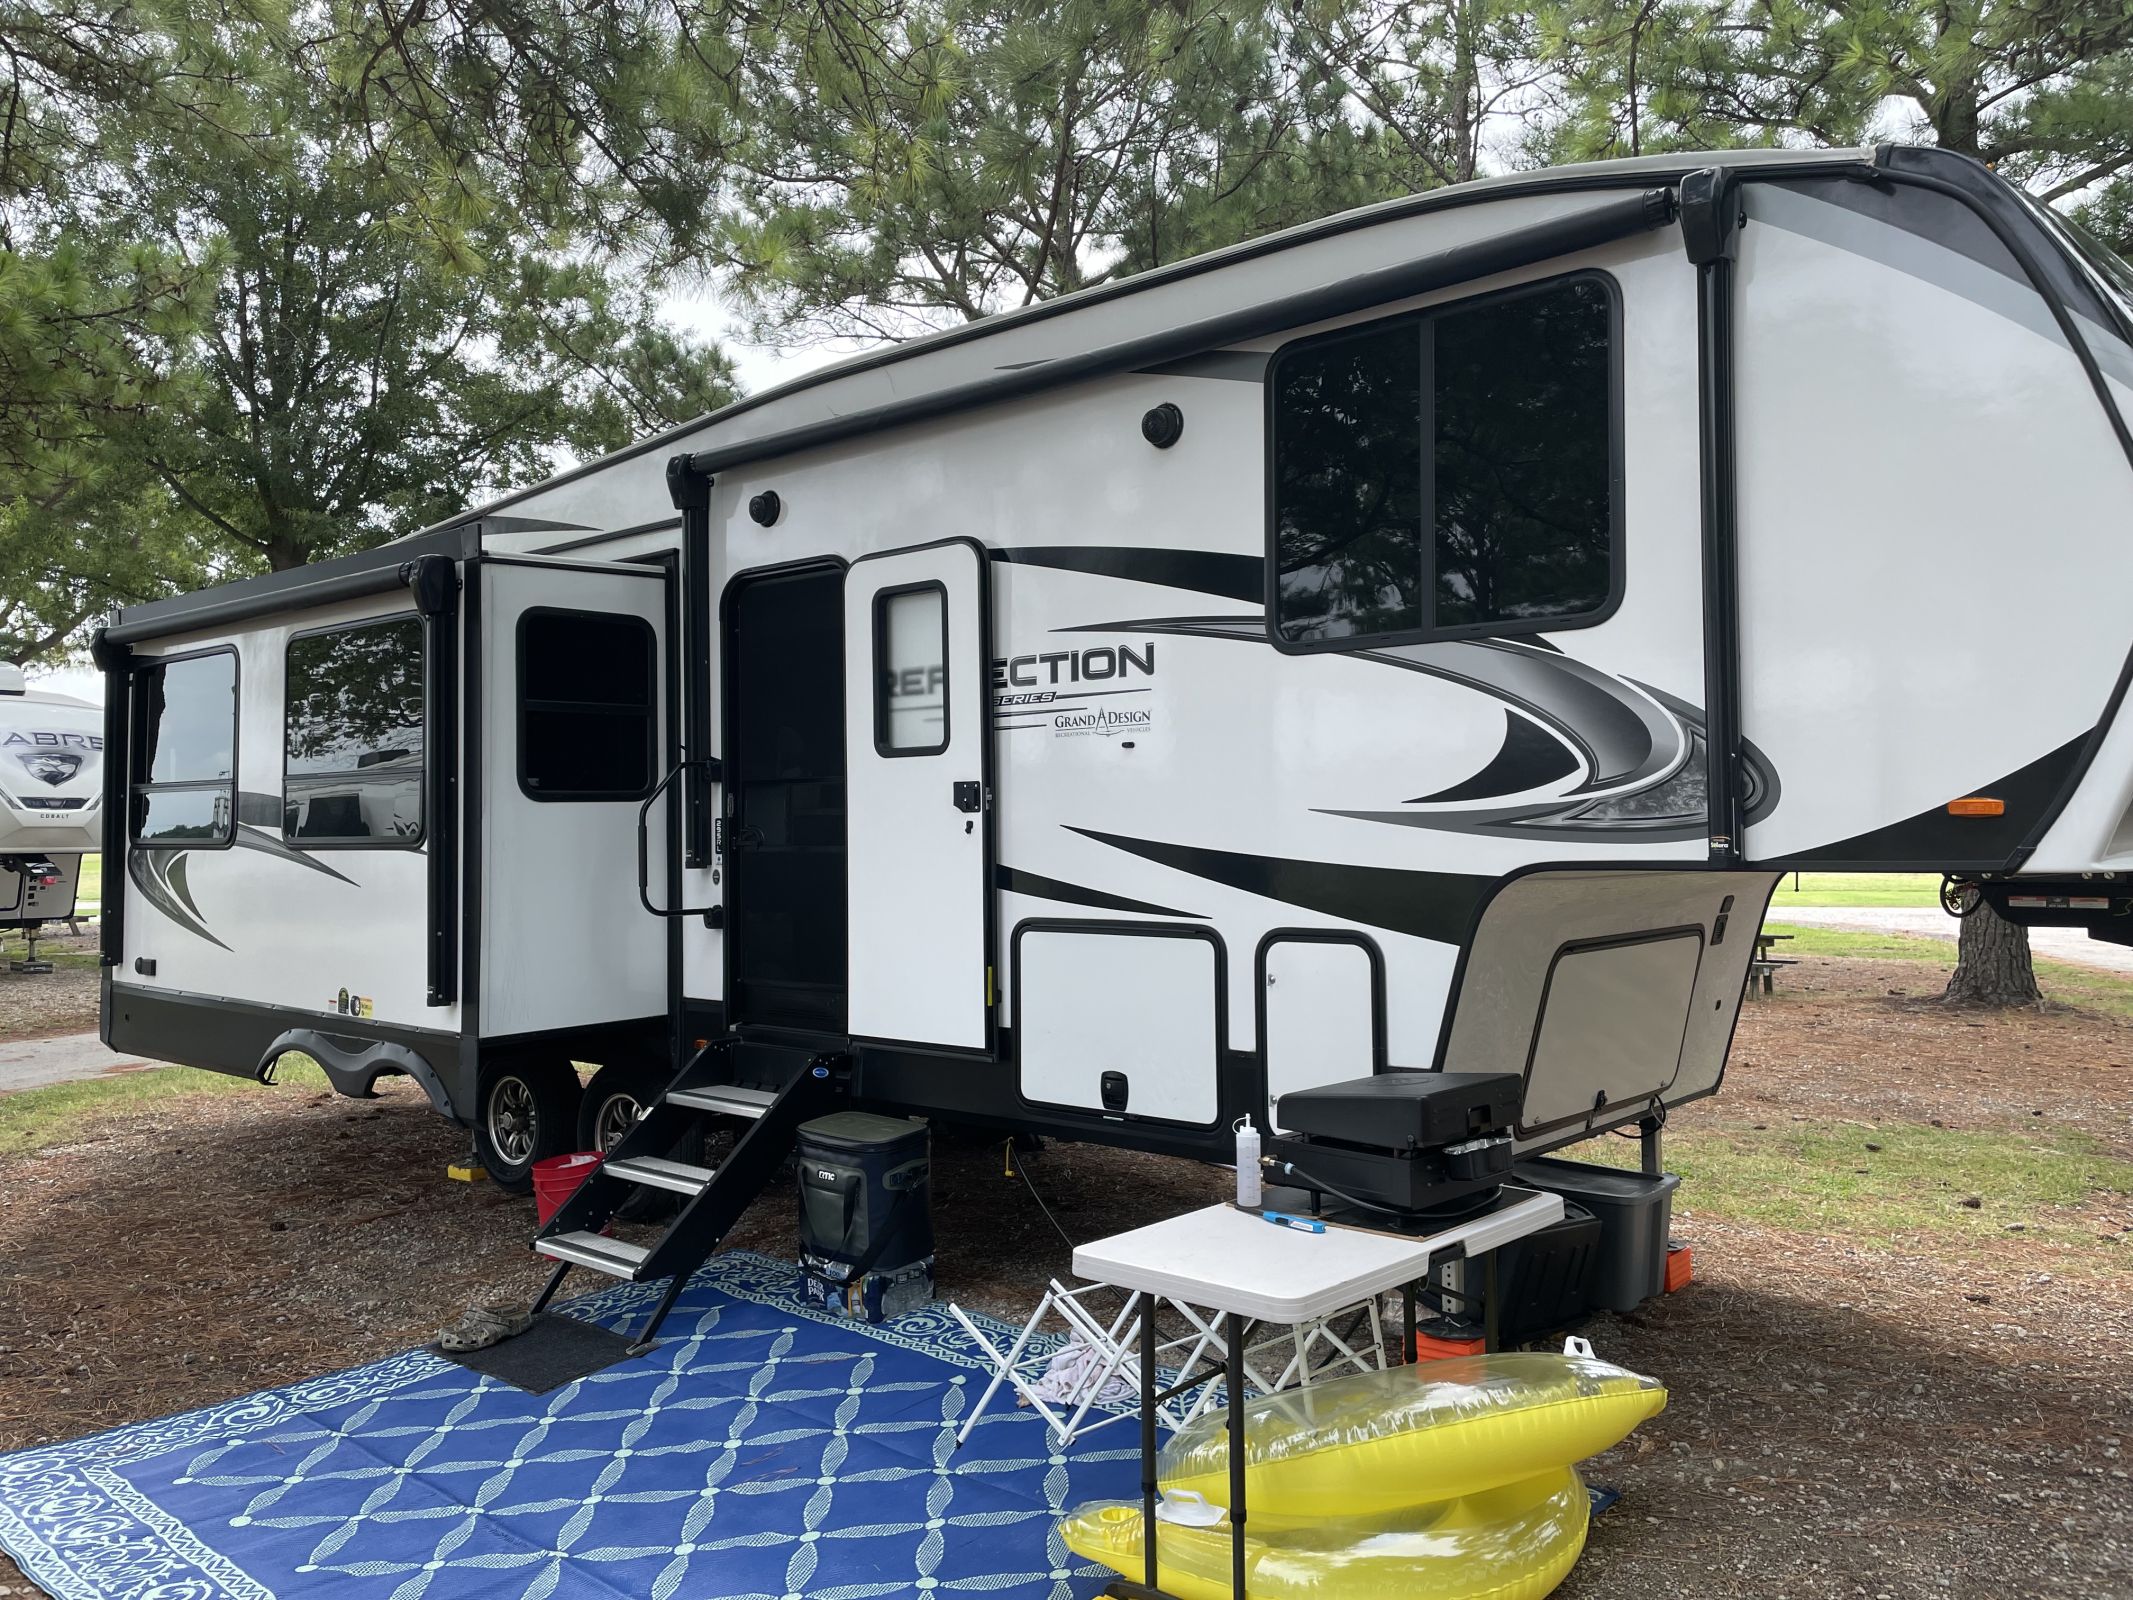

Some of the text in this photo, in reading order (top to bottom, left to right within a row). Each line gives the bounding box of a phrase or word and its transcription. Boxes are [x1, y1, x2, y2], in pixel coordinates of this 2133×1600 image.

[1055, 710, 1151, 728] GRAND DESIGN
[808, 1287, 825, 1302] PARK
